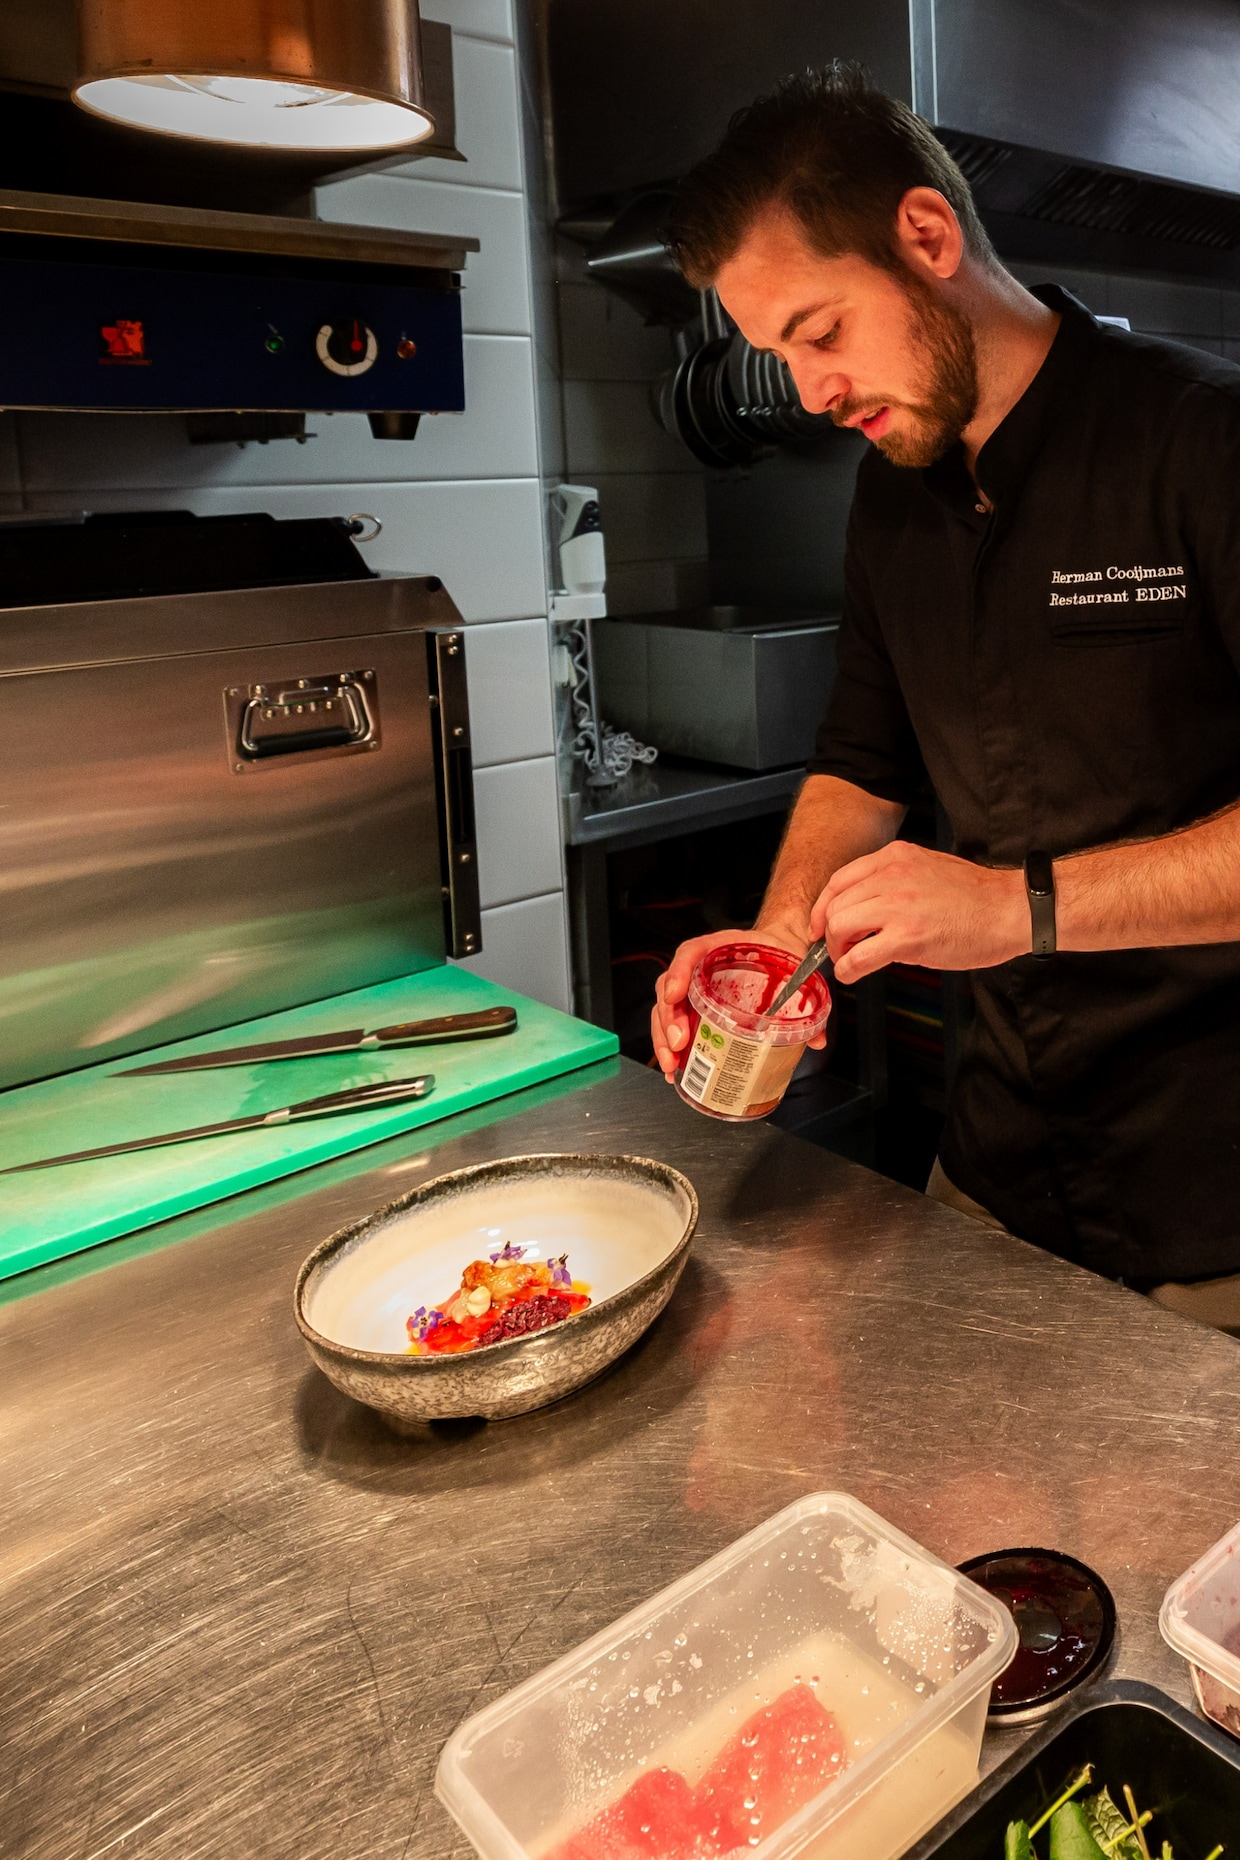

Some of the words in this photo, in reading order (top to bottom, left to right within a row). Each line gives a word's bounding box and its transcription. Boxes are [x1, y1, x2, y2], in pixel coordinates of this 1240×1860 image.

[1051, 571, 1103, 584] Herman
[1106, 566, 1185, 581] Cooijmans
[1049, 590, 1129, 606] Restaurant
[1135, 585, 1187, 602] EDEN
